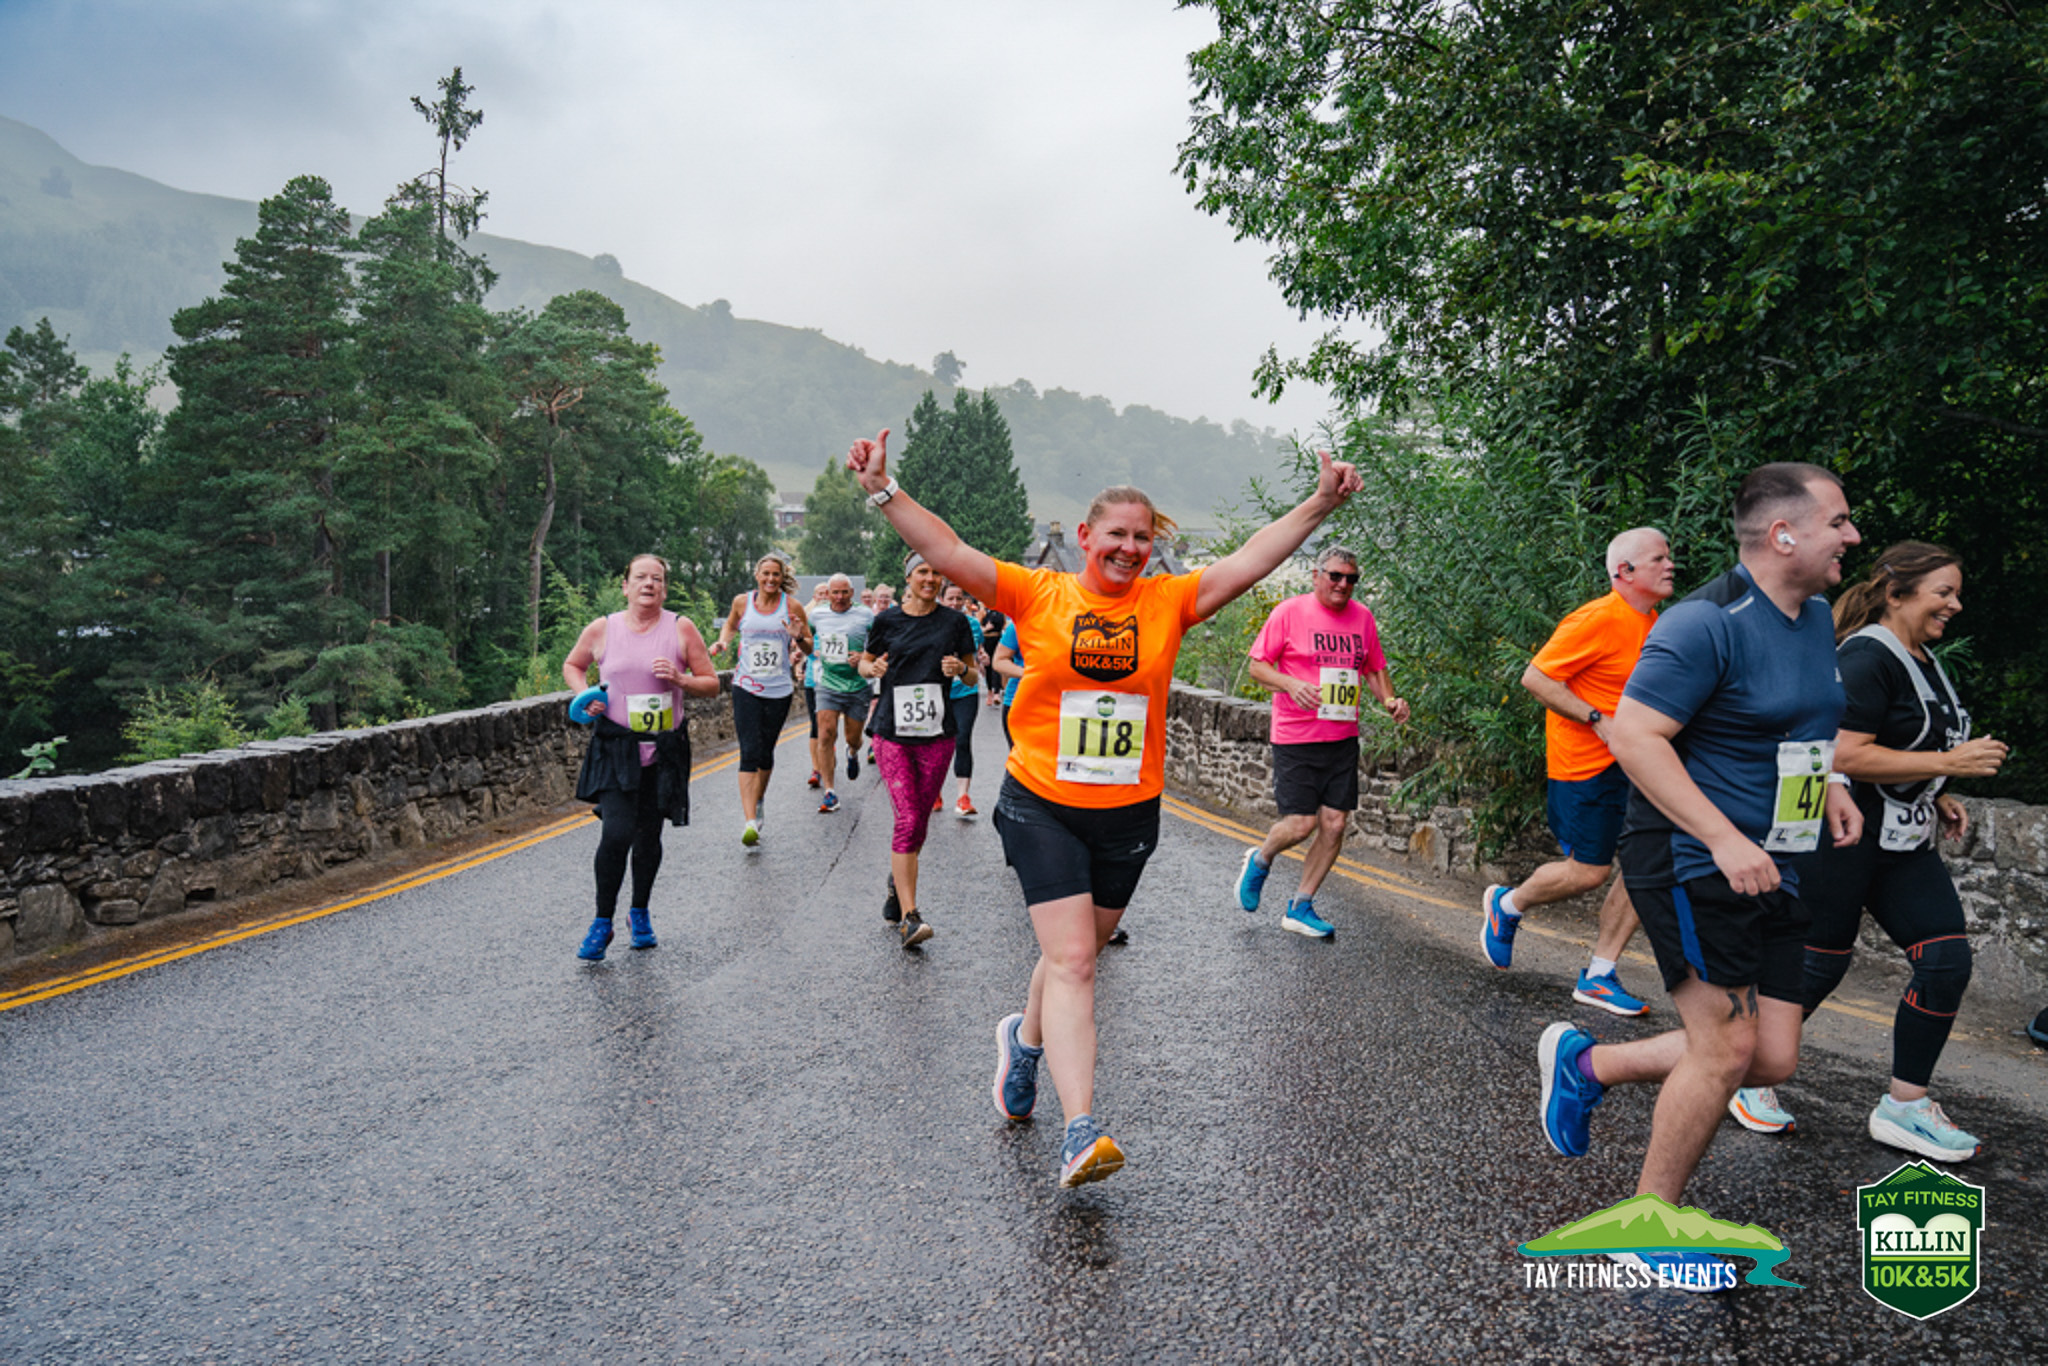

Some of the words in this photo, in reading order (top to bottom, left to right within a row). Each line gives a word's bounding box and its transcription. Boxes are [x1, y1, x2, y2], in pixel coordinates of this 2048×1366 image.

[1078, 617, 1097, 627] TAY
[825, 641, 844, 655] 772
[1079, 637, 1132, 651] KILLIN
[1314, 633, 1351, 653] RUN
[1075, 655, 1135, 671] 10K&5K
[1329, 684, 1356, 705] 109
[903, 699, 937, 722] 354
[643, 711, 663, 731] 91
[1078, 718, 1132, 756] 118
[1797, 776, 1825, 819] 47
